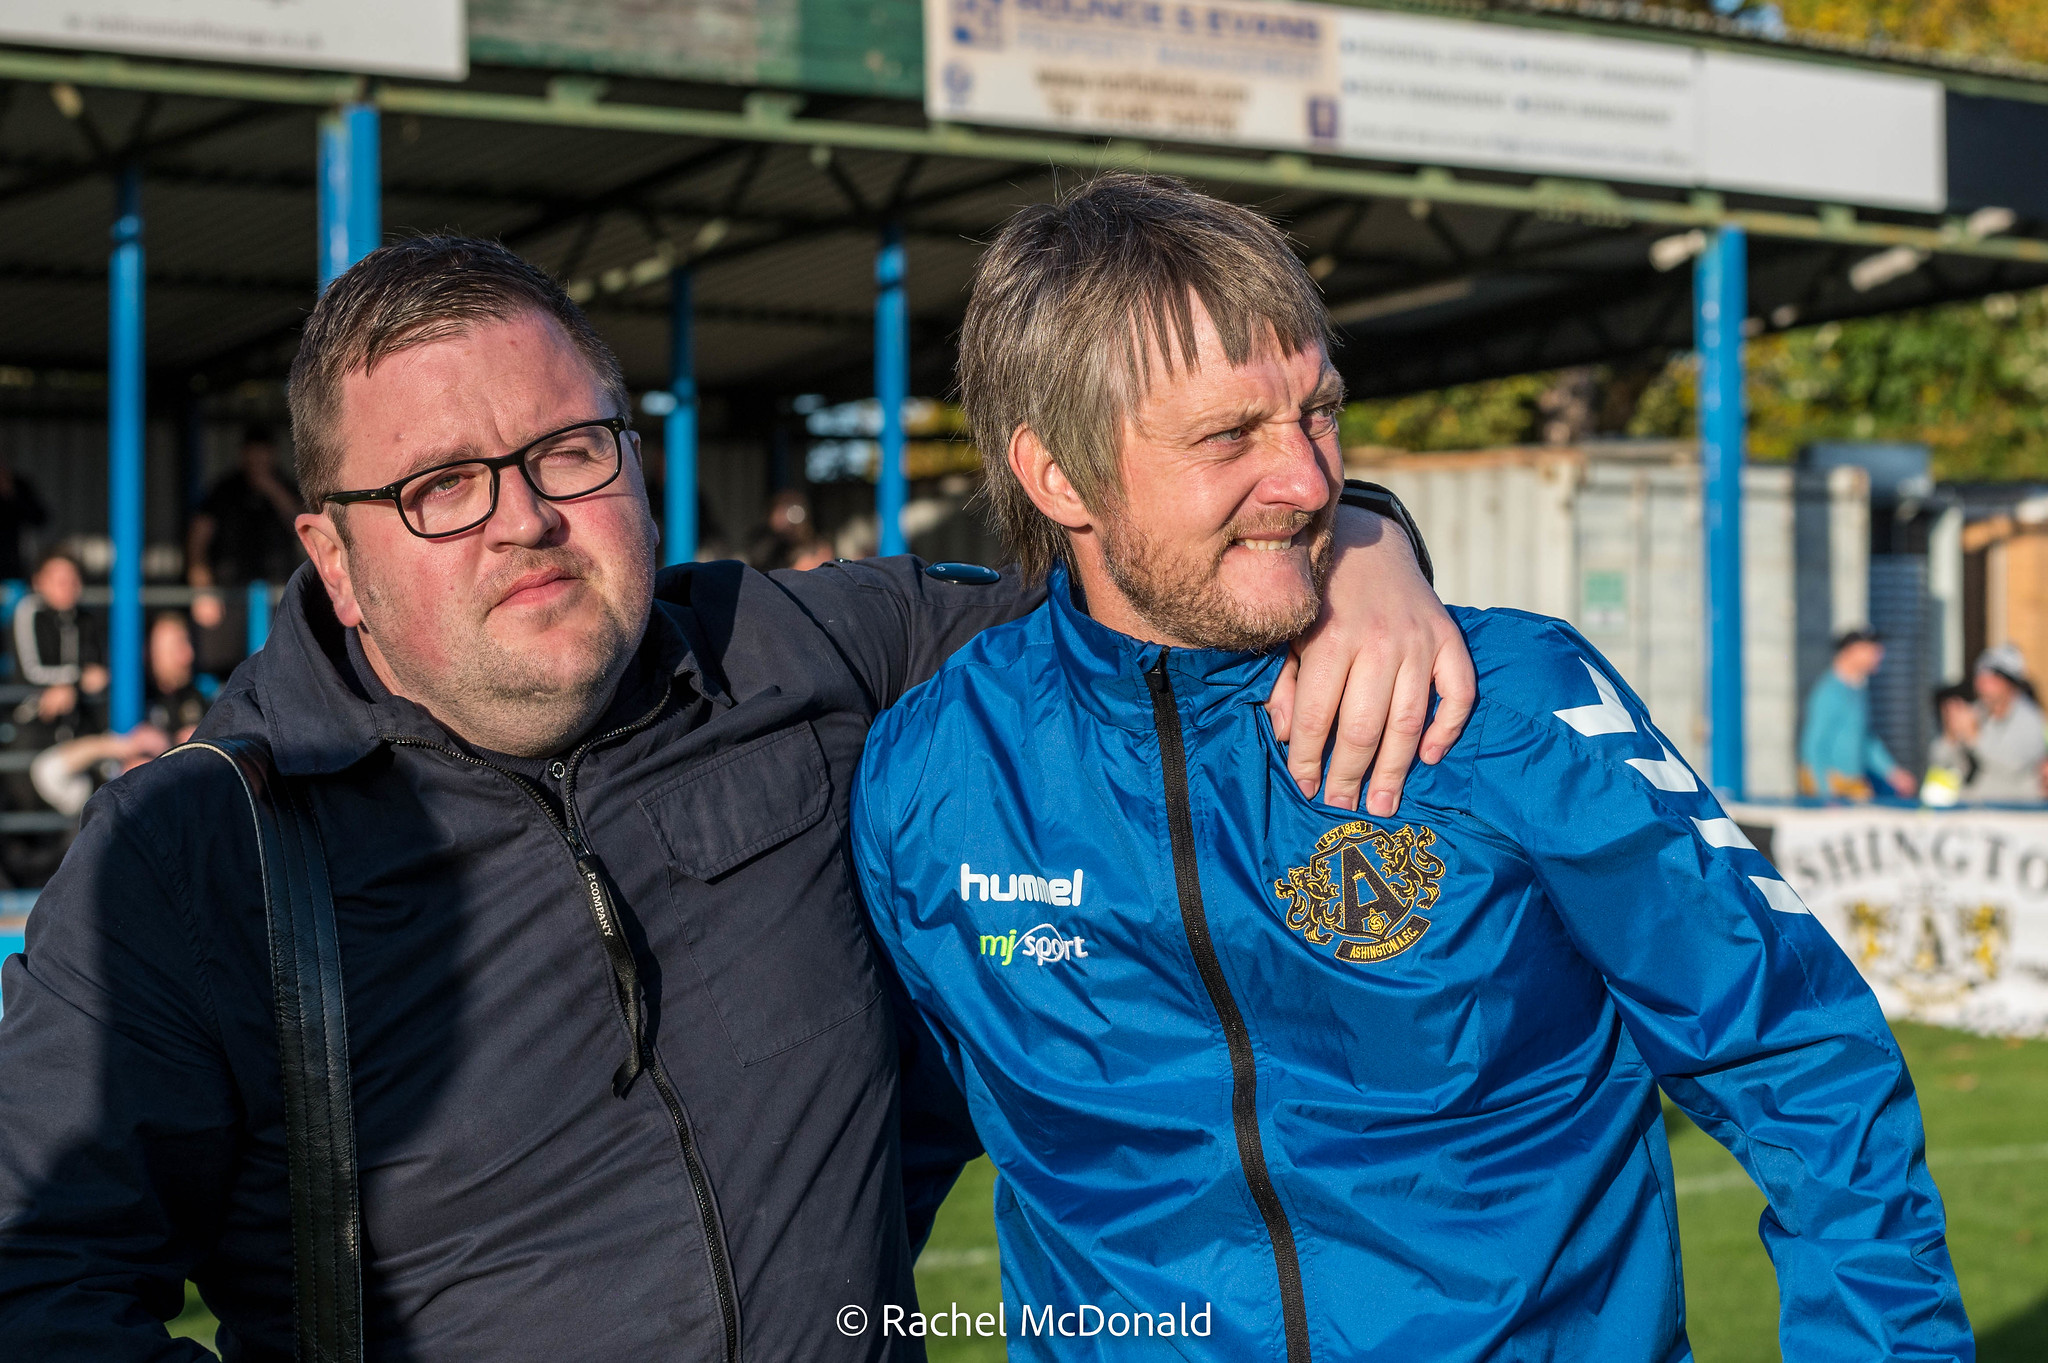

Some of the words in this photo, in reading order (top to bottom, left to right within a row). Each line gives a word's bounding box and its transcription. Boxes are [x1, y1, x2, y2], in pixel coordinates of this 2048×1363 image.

[1341, 822, 1362, 837] 1883
[960, 863, 1084, 907] hummel
[1022, 934, 1089, 966] sport
[1349, 938, 1400, 960] ASHINGTON
